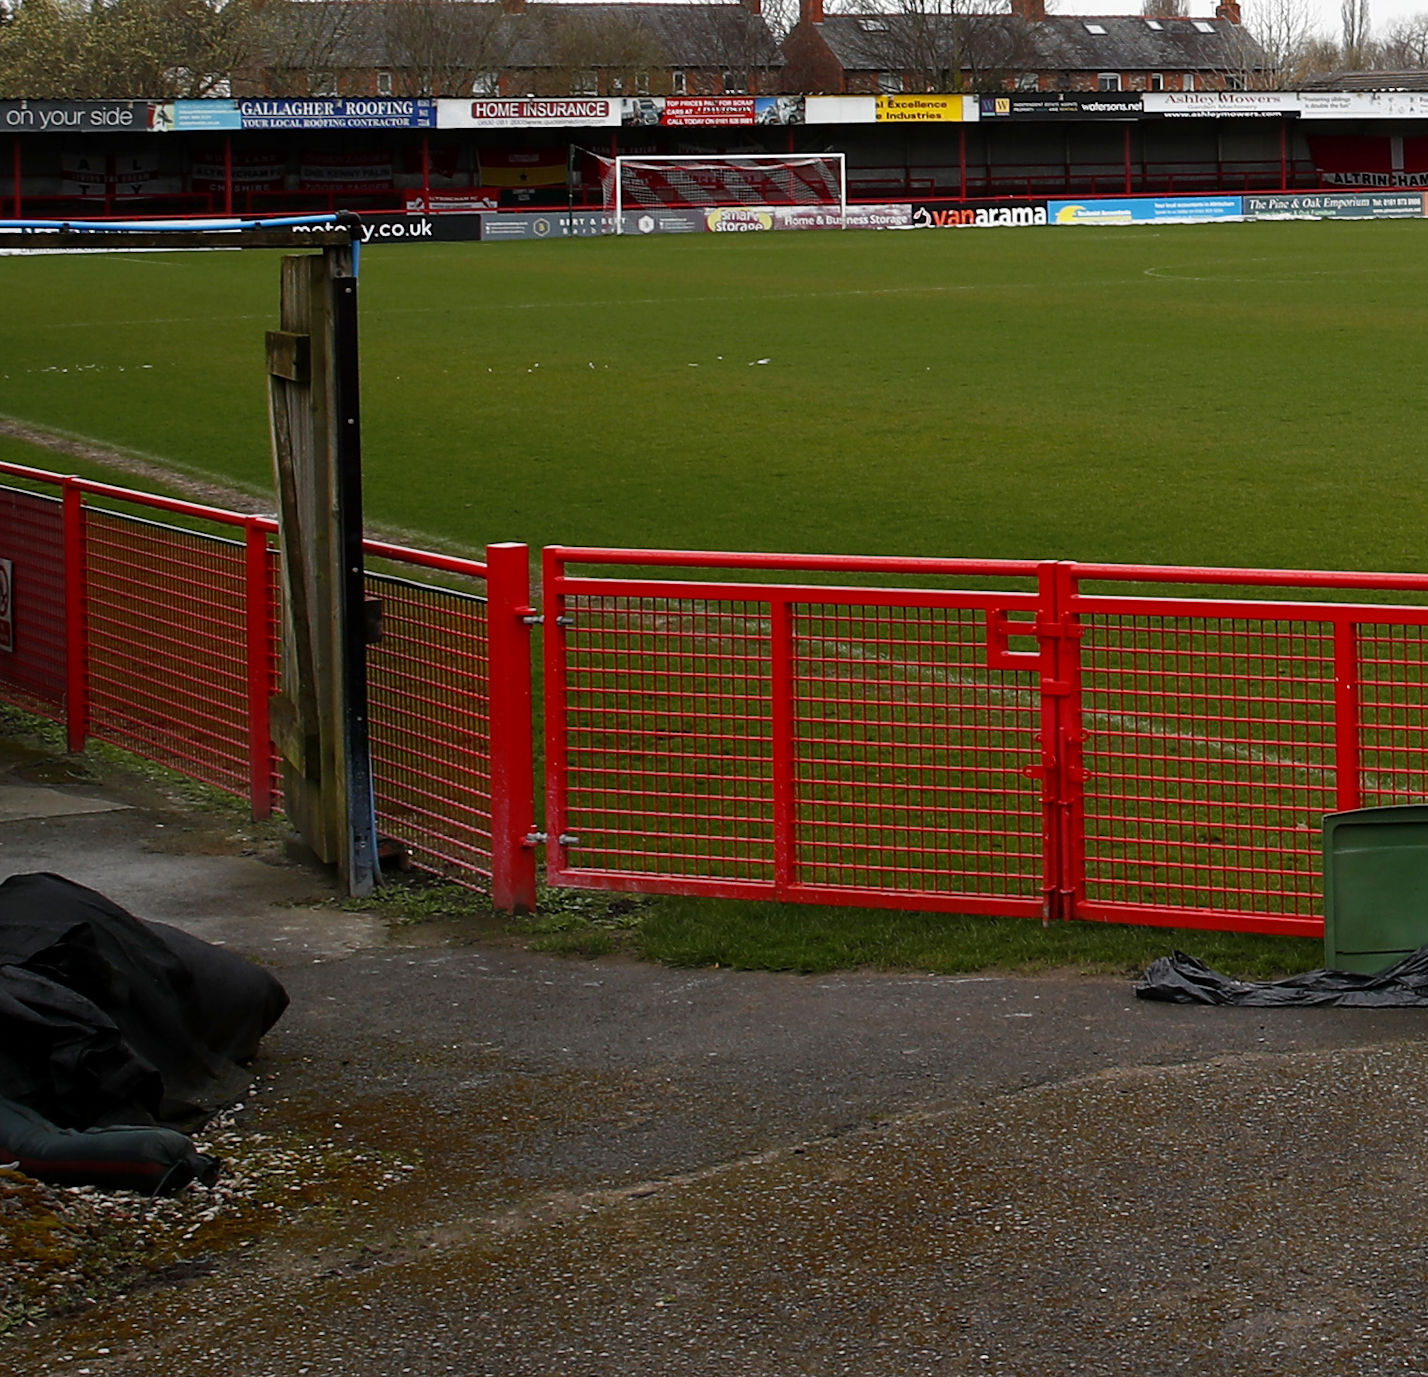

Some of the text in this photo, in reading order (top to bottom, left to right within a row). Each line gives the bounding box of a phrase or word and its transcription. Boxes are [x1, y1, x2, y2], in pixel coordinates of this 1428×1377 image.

[887, 99, 947, 108] Excellence
[1164, 94, 1281, 106] Ashley Mowers
[241, 101, 335, 116] GALLAGHER
[345, 100, 414, 116] ROOFING
[476, 101, 607, 117] HOME INSURANCE
[1164, 111, 1282, 119] www.ashleymowers.com
[6, 106, 134, 129] on your side
[242, 117, 411, 128] YOUR LOCAL ROOFING CONTRACTOR
[886, 111, 942, 120] Industries
[1249, 199, 1267, 210] The
[1268, 198, 1289, 210] Pine
[1290, 198, 1300, 208] &
[1302, 197, 1321, 208] Oak
[1323, 196, 1370, 210] Emporium
[784, 213, 908, 228] Home & Busness Storage
[932, 206, 1047, 226] vanarama
